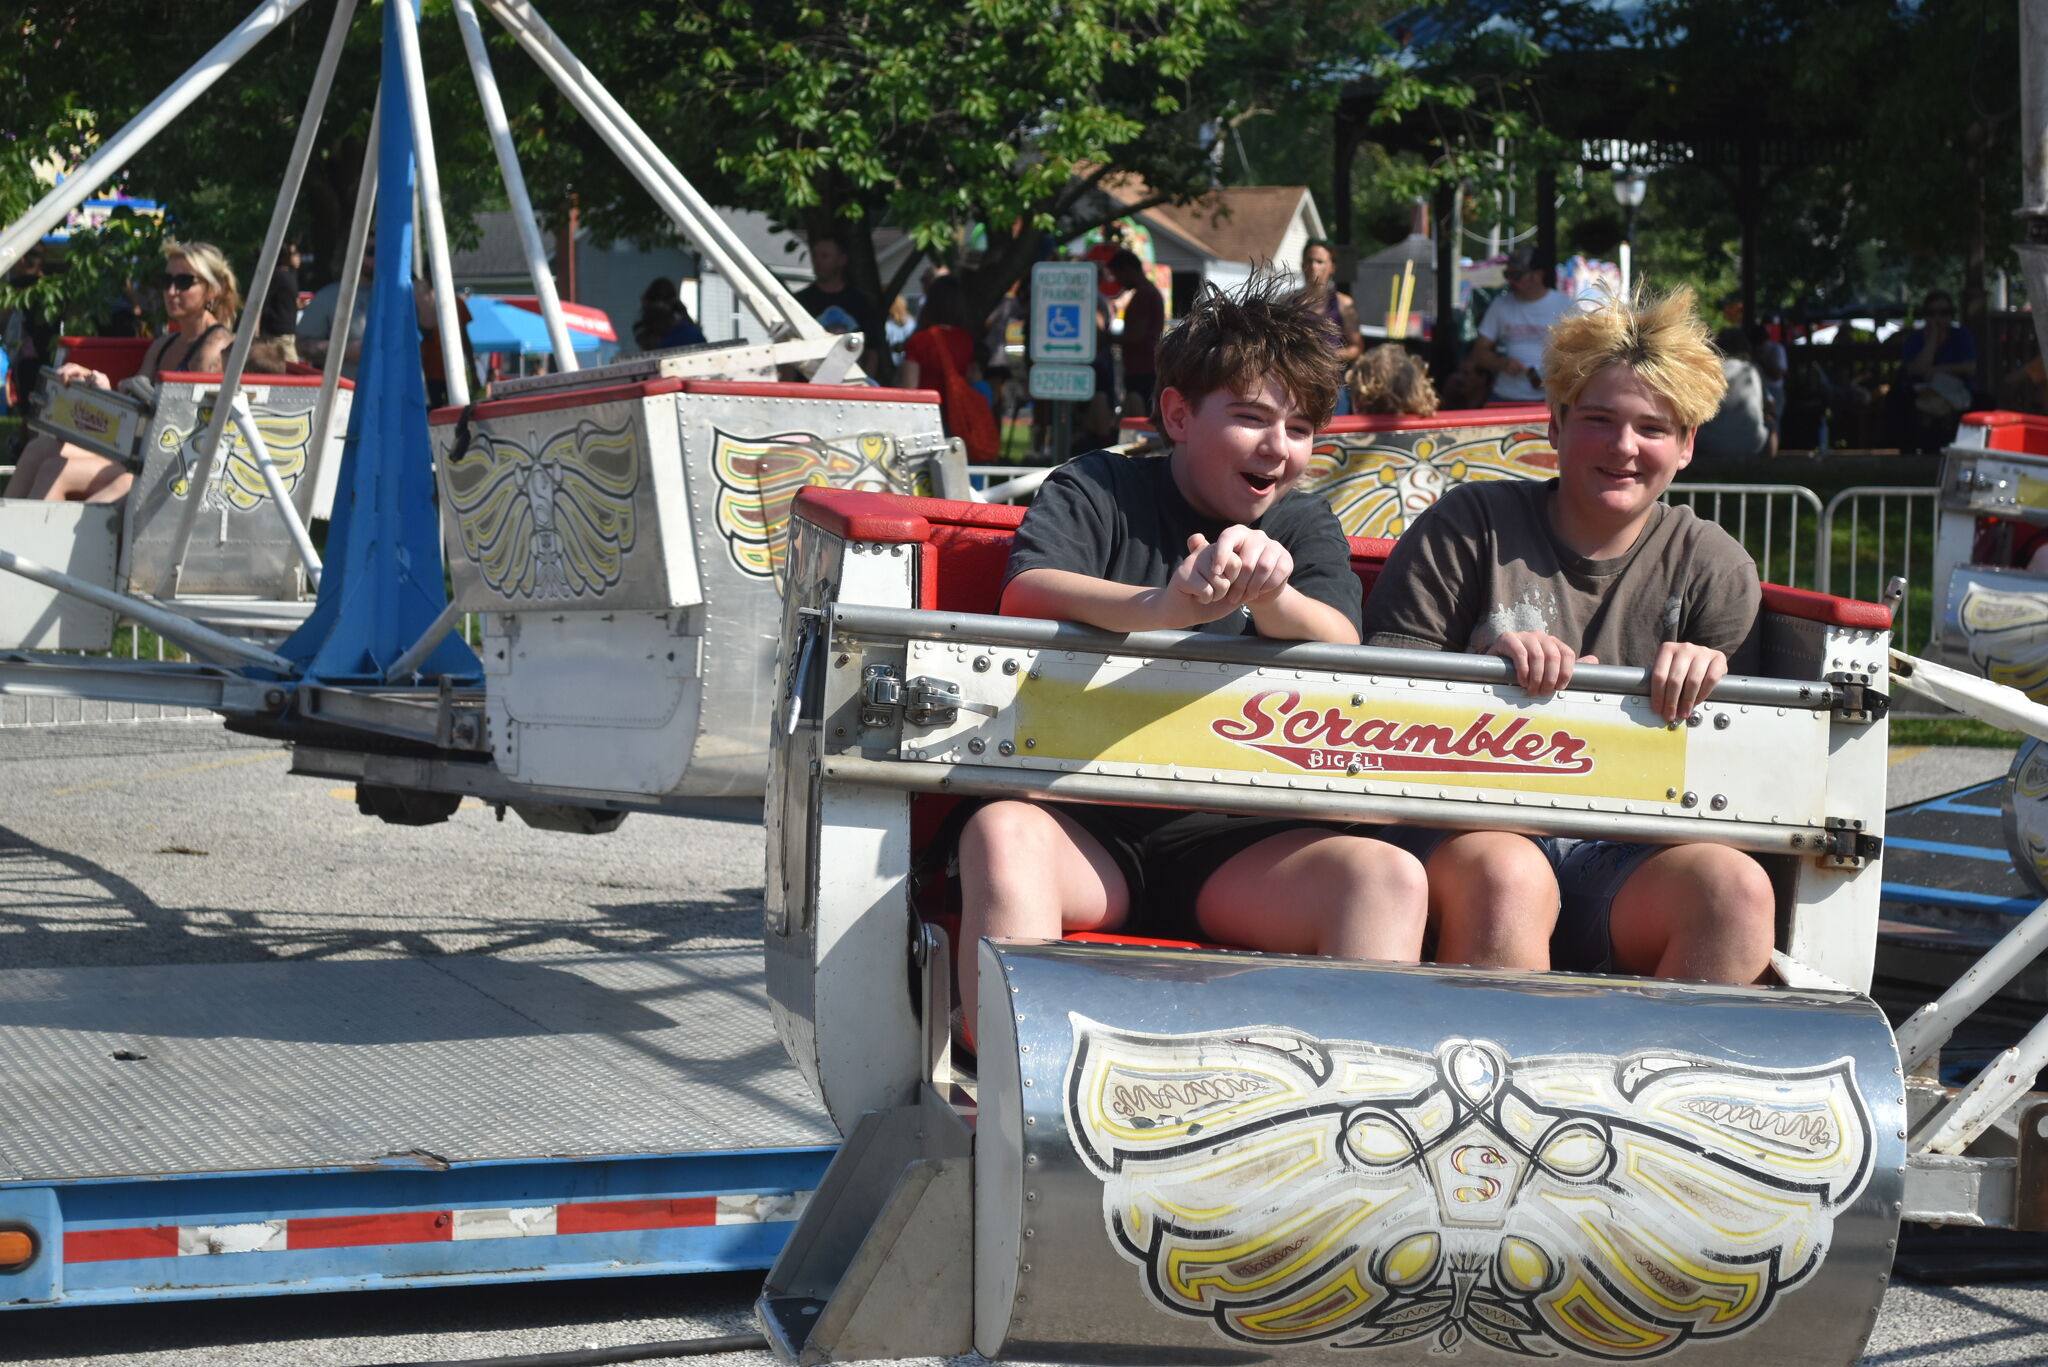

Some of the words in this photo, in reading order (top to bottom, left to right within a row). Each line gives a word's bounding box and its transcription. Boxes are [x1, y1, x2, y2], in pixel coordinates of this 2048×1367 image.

[1038, 272, 1089, 286] RESERVED
[1042, 287, 1085, 300] PARKING
[1065, 373, 1088, 392] FINE
[1211, 689, 1593, 771] Scrambler
[1307, 749, 1345, 768] BIG
[1451, 1145, 1507, 1203] S
